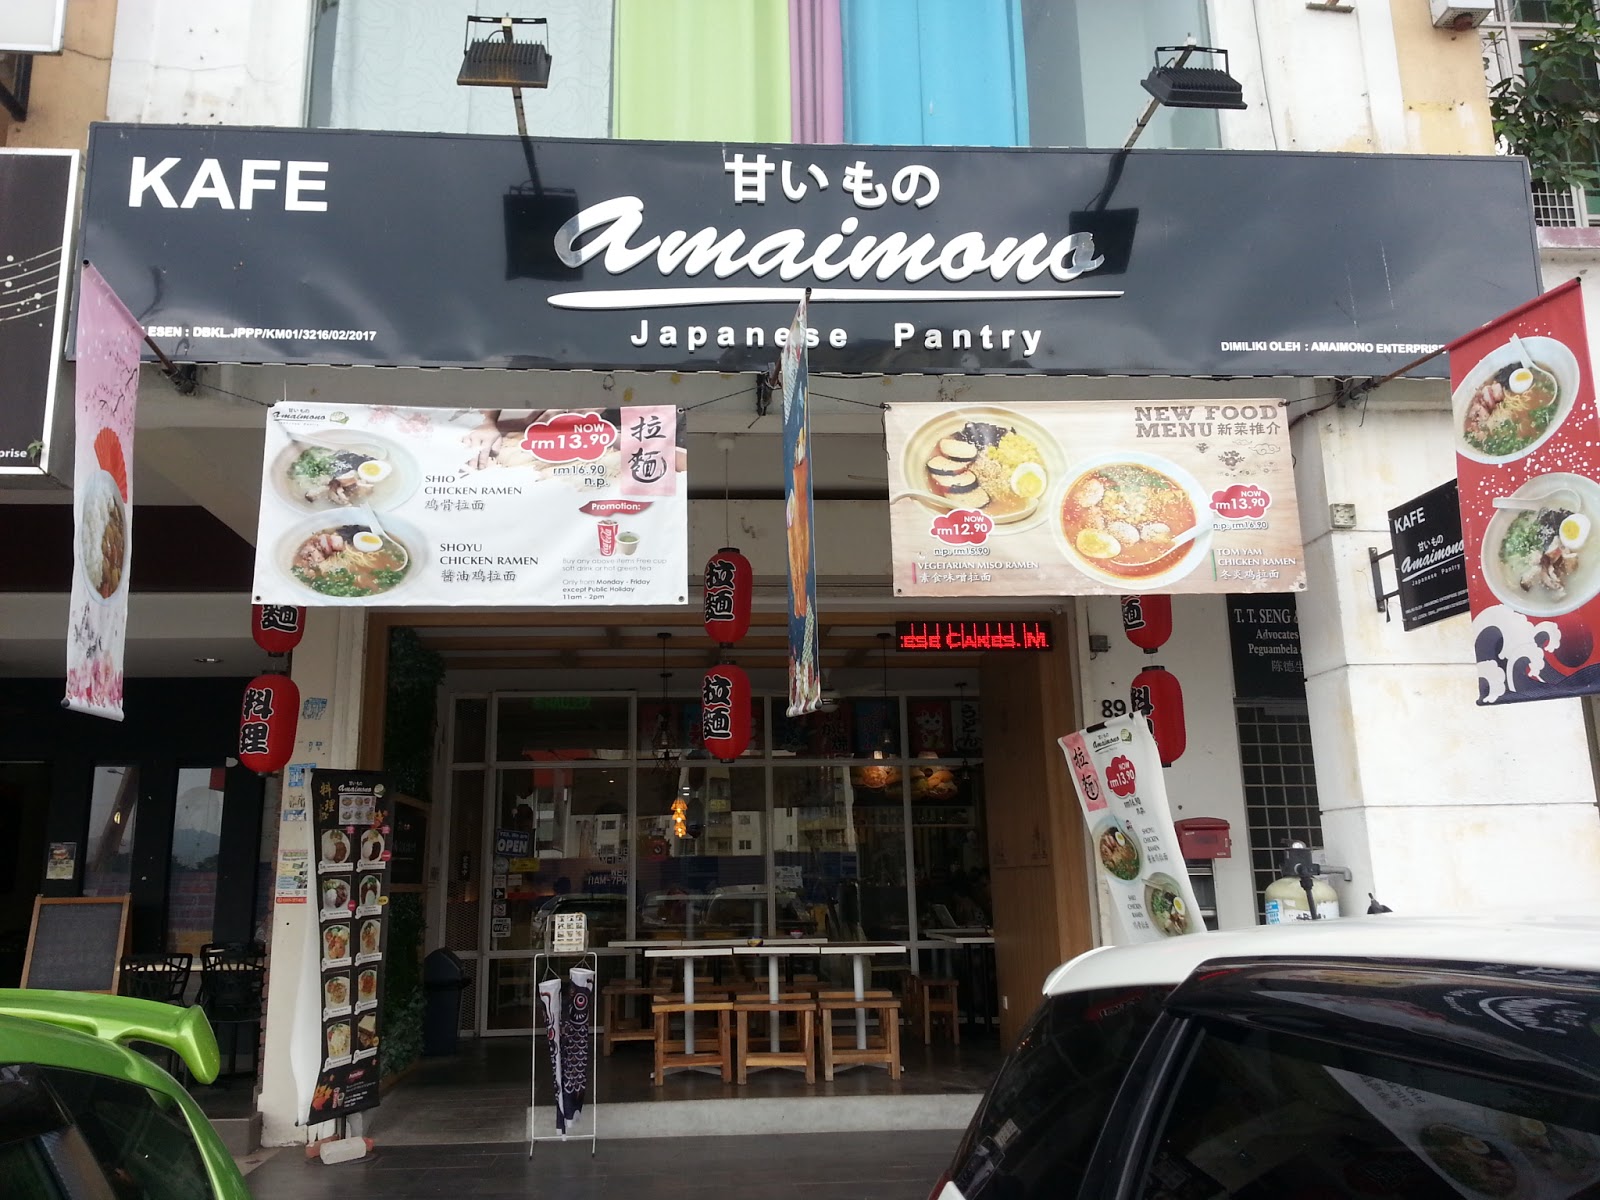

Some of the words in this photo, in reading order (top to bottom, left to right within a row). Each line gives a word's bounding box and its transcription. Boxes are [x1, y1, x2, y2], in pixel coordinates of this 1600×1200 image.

[128, 156, 329, 212] KAFE
[724, 153, 941, 208] 甘いもの
[141, 325, 182, 337] ESEN
[630, 319, 849, 351] Japanese
[894, 321, 1042, 357] Pantry
[1221, 341, 1267, 352] DIMILIKI
[1269, 341, 1301, 352] OLEH
[1311, 342, 1374, 353] AMAIMONO
[1134, 406, 1196, 421] NEW
[1204, 405, 1278, 420] FOOD
[573, 423, 605, 433] NOW
[1135, 422, 1213, 438] MENU
[1217, 421, 1281, 436] 新菜推介
[531, 433, 611, 450] rm13.90
[553, 464, 605, 476] rm16.90
[425, 475, 456, 483] SHIO
[584, 477, 609, 488] n.p.
[424, 486, 478, 495] CHICKEN
[481, 486, 523, 495] RAMEN
[591, 502, 641, 511] Promotion:
[1215, 498, 1266, 510] rm13.90
[963, 515, 985, 523] NOW
[1394, 507, 1426, 534] KAFE
[936, 523, 988, 536] rm12.90
[440, 543, 483, 552] SHOYU
[1417, 534, 1444, 553] 甘いもの
[1216, 548, 1240, 556] TOM
[1241, 548, 1263, 556] YAM
[440, 556, 493, 565] CHICKEN
[497, 556, 539, 566] RAMEN
[917, 562, 976, 570] VEGETARIAN
[977, 561, 1003, 570] MISO
[1005, 561, 1039, 570] RAMEN
[1218, 558, 1260, 566] CHICKEN
[1262, 557, 1296, 566] RAMEN
[1411, 572, 1438, 587] Japanese
[1441, 563, 1461, 575] Pantry
[630, 578, 651, 586] Friday
[1259, 608, 1291, 624] SENG
[1256, 629, 1299, 640] Advocates
[1248, 643, 1298, 656] Peguambela
[1102, 699, 1127, 718] 89
[1118, 761, 1130, 770] NOW
[1109, 769, 1135, 788] rm13.90
[497, 838, 528, 853] OPEN
